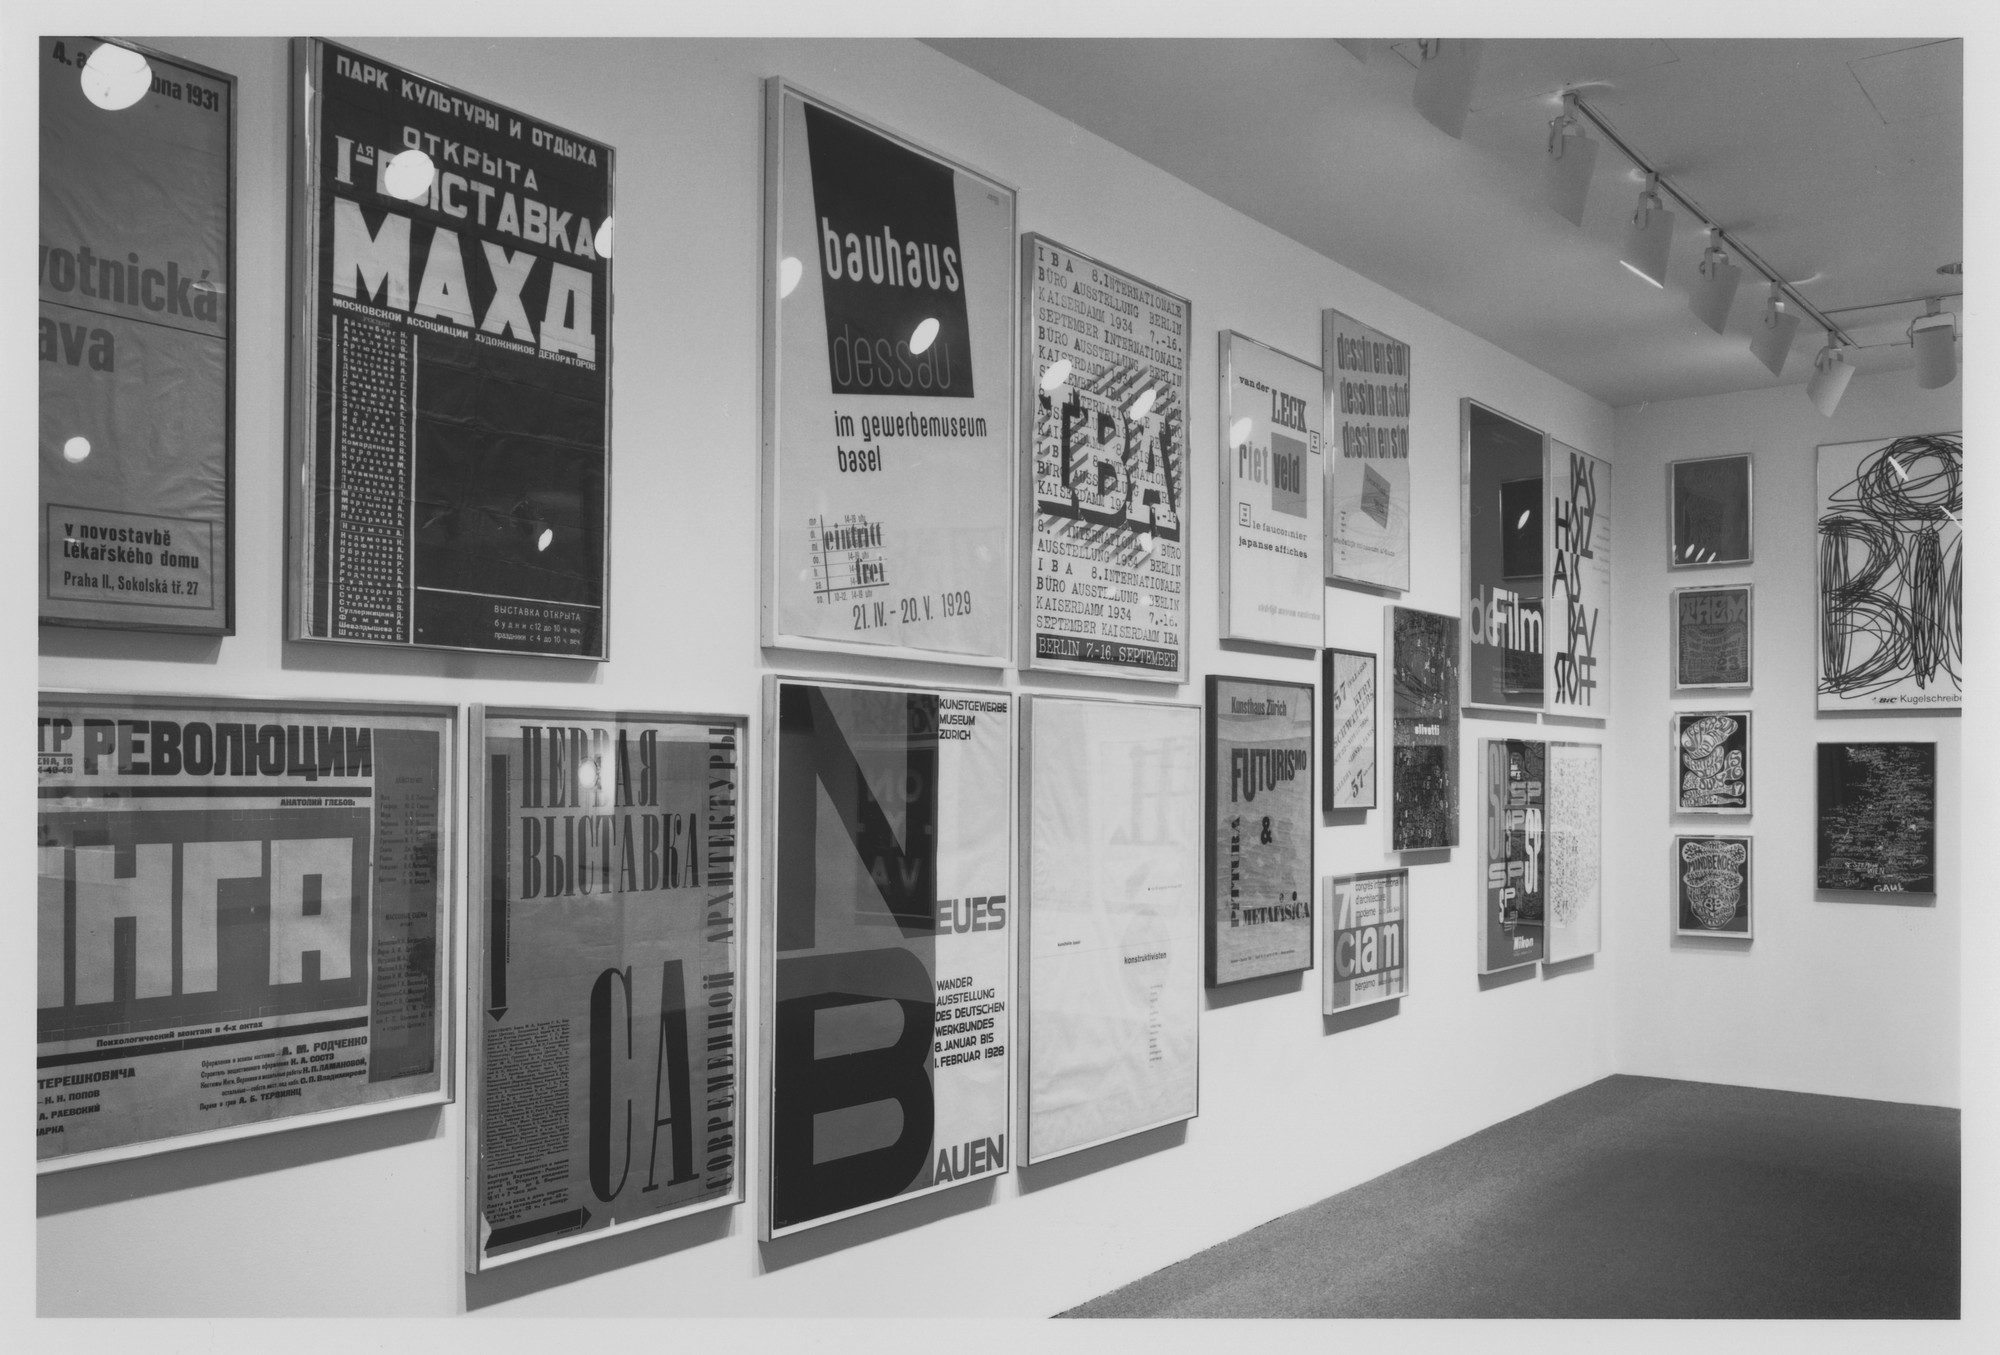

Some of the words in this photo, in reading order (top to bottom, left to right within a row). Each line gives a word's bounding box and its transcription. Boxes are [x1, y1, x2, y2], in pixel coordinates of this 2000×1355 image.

[186, 82, 220, 112] 1931
[336, 54, 389, 91] ПАРК
[401, 78, 499, 132] КУЛЬТУРЫ
[509, 118, 521, 140] И
[531, 127, 598, 168] ОТДЫХА
[403, 125, 538, 192] ОТКРЫТА
[821, 216, 960, 292] bauhaus
[333, 196, 596, 363] МАХД
[1038, 286, 1105, 323] KAISERDAMM
[1110, 313, 1133, 334] 1934
[1073, 281, 1140, 318] AUSSTELLUNG
[1149, 311, 1182, 336] BERLIN
[406, 316, 468, 339] АССОЦИАЦИИ
[475, 334, 535, 356] ХУДОЖНИКОВ
[538, 349, 597, 371] ДЕКОРАТОРОВ
[1039, 307, 1099, 339] SEPTEMBER
[1104, 330, 1182, 370] INTERNATIONALE
[1074, 338, 1139, 371] AUSSTELLUNG
[1149, 365, 1182, 387] BERLIN
[1239, 376, 1255, 388] van
[1256, 382, 1270, 393] der
[1271, 389, 1307, 433] LECK
[834, 410, 855, 437] im
[861, 411, 987, 443] gewerbemuseum
[837, 445, 882, 473] basel
[1273, 453, 1300, 495] veld
[64, 523, 74, 537] v
[80, 524, 171, 547] novostavbě
[824, 520, 882, 551] eintritt
[1239, 536, 1273, 551] japanse
[160, 550, 199, 569] domu
[856, 555, 885, 585] frei
[1037, 539, 1110, 563] AUSSTELLUNG
[1115, 553, 1139, 568] 1934
[1150, 559, 1181, 577] BERLIN
[64, 571, 98, 589] Praha
[118, 576, 168, 594] Sokolská
[187, 581, 199, 596] 27
[1036, 575, 1066, 592] BÜRO
[1149, 594, 1180, 611] BERLIN
[494, 605, 540, 618] ВЫСТАВКА
[543, 610, 581, 621] ОТКРЫТА
[853, 603, 871, 631] 21.
[901, 597, 921, 624] 20.
[942, 590, 972, 618] 1929
[1036, 595, 1104, 617] KAISERDAMM
[1108, 605, 1132, 621] 1934
[1036, 615, 1096, 634] SEPTEMBER
[1102, 622, 1160, 643] KAISERDAMM
[1164, 632, 1179, 645] IBA
[1039, 636, 1080, 657] BERLIN
[1118, 646, 1177, 668] SEPTEMBER
[939, 698, 1007, 713] KUNSTGEWERBE
[939, 713, 976, 726] MUSEUM
[1231, 696, 1265, 715] Kunsthaus
[1414, 723, 1440, 736] olivetti
[84, 719, 373, 782] РЕВОЛЮЦИИ
[1231, 748, 1307, 803] FUTURISMO
[520, 813, 701, 900] ВЫСТАВКА
[1513, 936, 1534, 950] Nikon
[1124, 952, 1167, 964] konstruktivisten
[936, 988, 995, 1006] AUSSTELLUNG
[937, 976, 973, 991] WANDER
[935, 1009, 952, 1022] DES
[955, 1001, 1005, 1019] DEUTSCHEN
[97, 1031, 175, 1047] Психологический
[935, 1017, 995, 1037] WERKBUNDES
[944, 1035, 977, 1051] JANUAR
[981, 1032, 994, 1045] BIS
[313, 1036, 368, 1052] РОДЧЕНКО
[940, 1050, 981, 1068] FEBRUAR
[984, 1045, 1005, 1060] 1928
[38, 1067, 136, 1089] ТЕРЕШКОВИЧА
[69, 1089, 100, 1101] ПОПОВ
